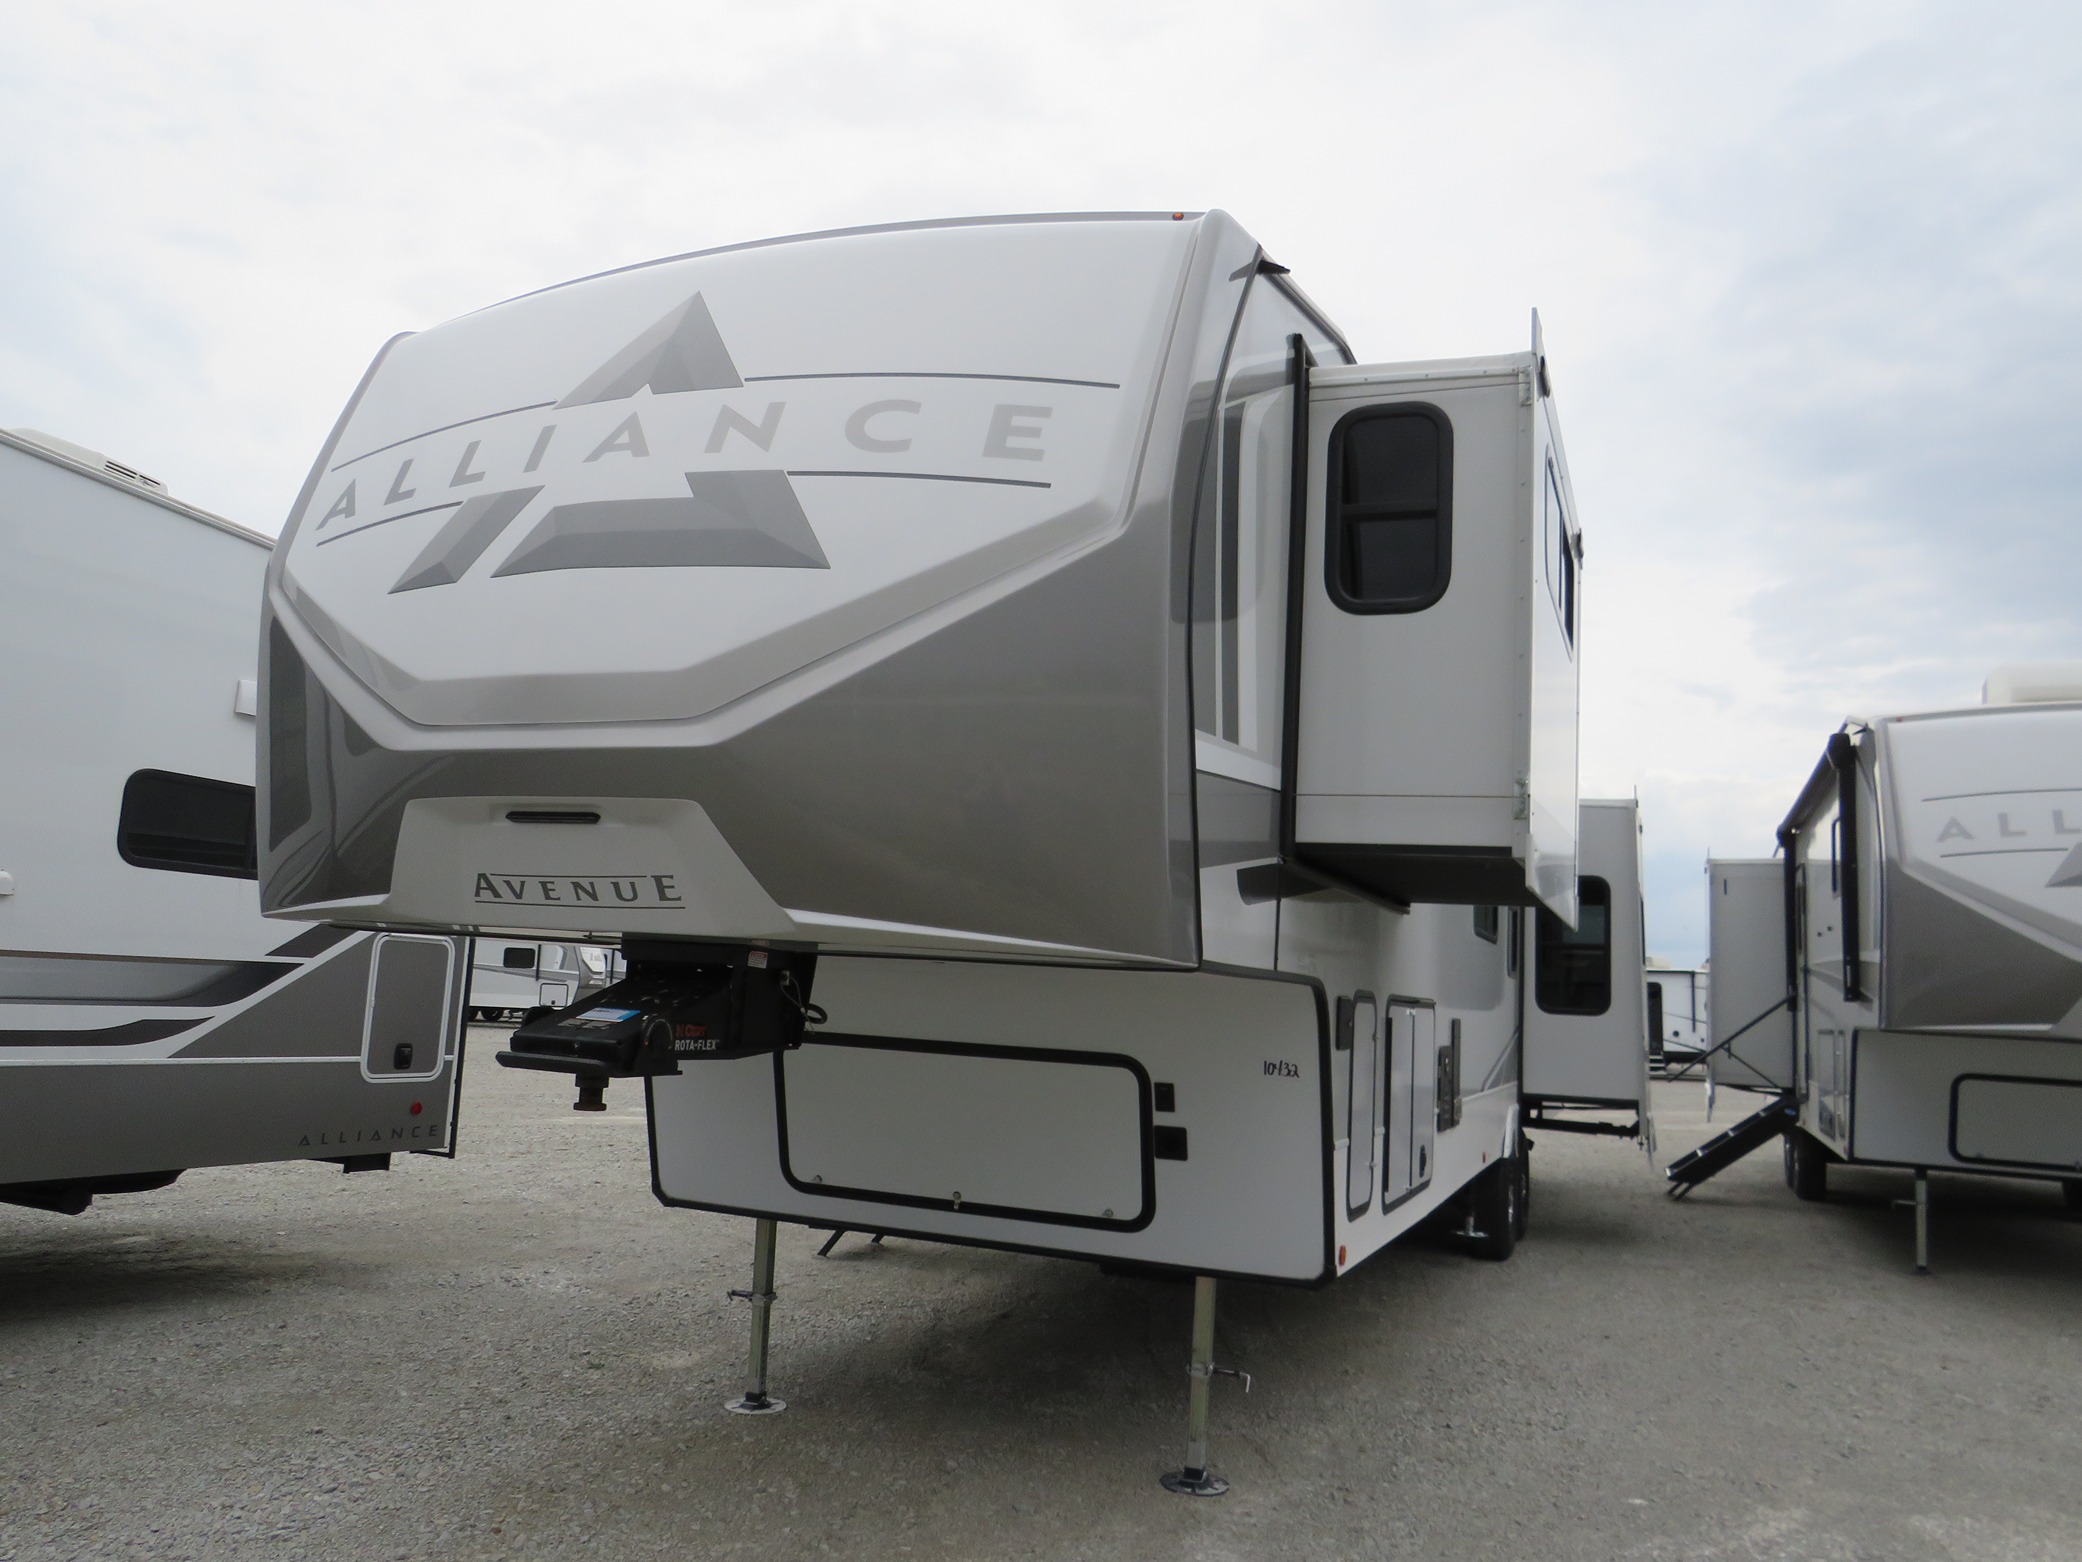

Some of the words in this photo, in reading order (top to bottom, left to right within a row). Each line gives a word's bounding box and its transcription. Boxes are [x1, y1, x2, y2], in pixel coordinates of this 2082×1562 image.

[315, 399, 1053, 531] ALLIANCE
[474, 873, 682, 902] AVENUE
[674, 1039, 717, 1051] ROTA-FLEX
[299, 1124, 438, 1146] ALLIANCE
